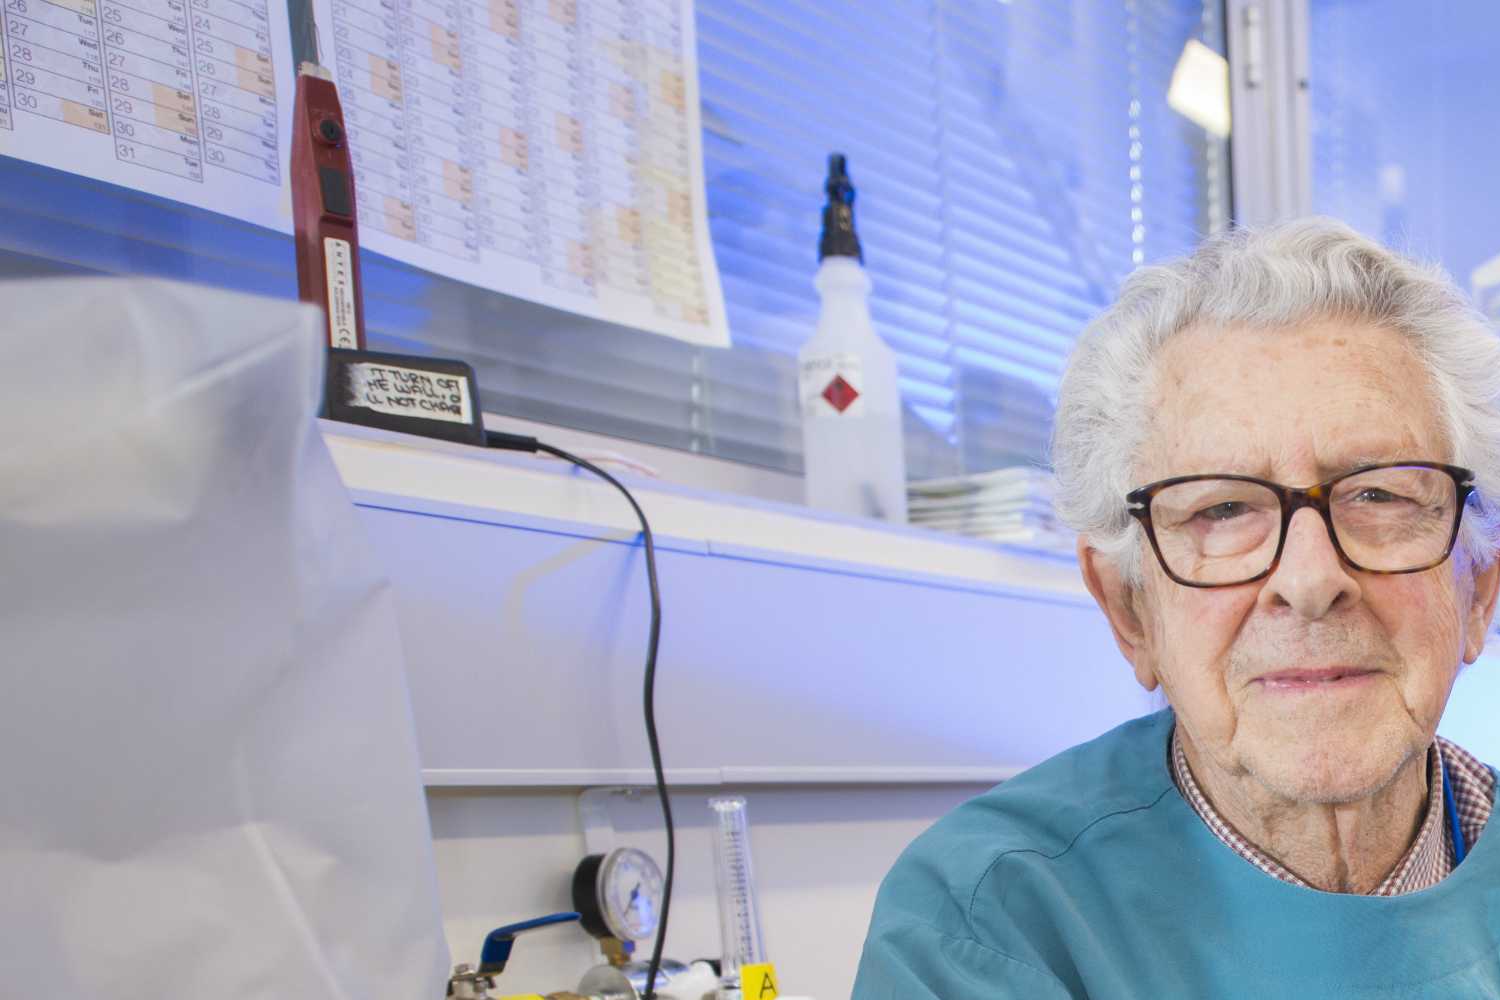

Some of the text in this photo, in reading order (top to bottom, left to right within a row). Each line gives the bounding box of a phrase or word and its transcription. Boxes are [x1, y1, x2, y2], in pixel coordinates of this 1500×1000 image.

[8, 0, 94, 26] 26 Tue
[103, 6, 186, 35] 25 Wed
[194, 15, 210, 30] 24
[9, 20, 98, 50] 27 Wed
[106, 28, 125, 45] 26
[197, 39, 214, 53] 25
[12, 44, 99, 73] 28 Thu
[109, 52, 126, 67] 27
[199, 60, 216, 75] 26
[16, 69, 99, 95] 29 Fri
[111, 75, 129, 91] 28
[200, 82, 216, 96] 27
[17, 92, 37, 109] 30
[114, 98, 132, 113] 29
[204, 104, 221, 119] 28
[116, 120, 134, 137] 30
[207, 126, 223, 141] 29
[119, 144, 136, 159] 31
[208, 148, 224, 163] 30
[388, 370, 433, 386] TURN
[386, 396, 416, 408] NOT
[759, 973, 777, 999] A
